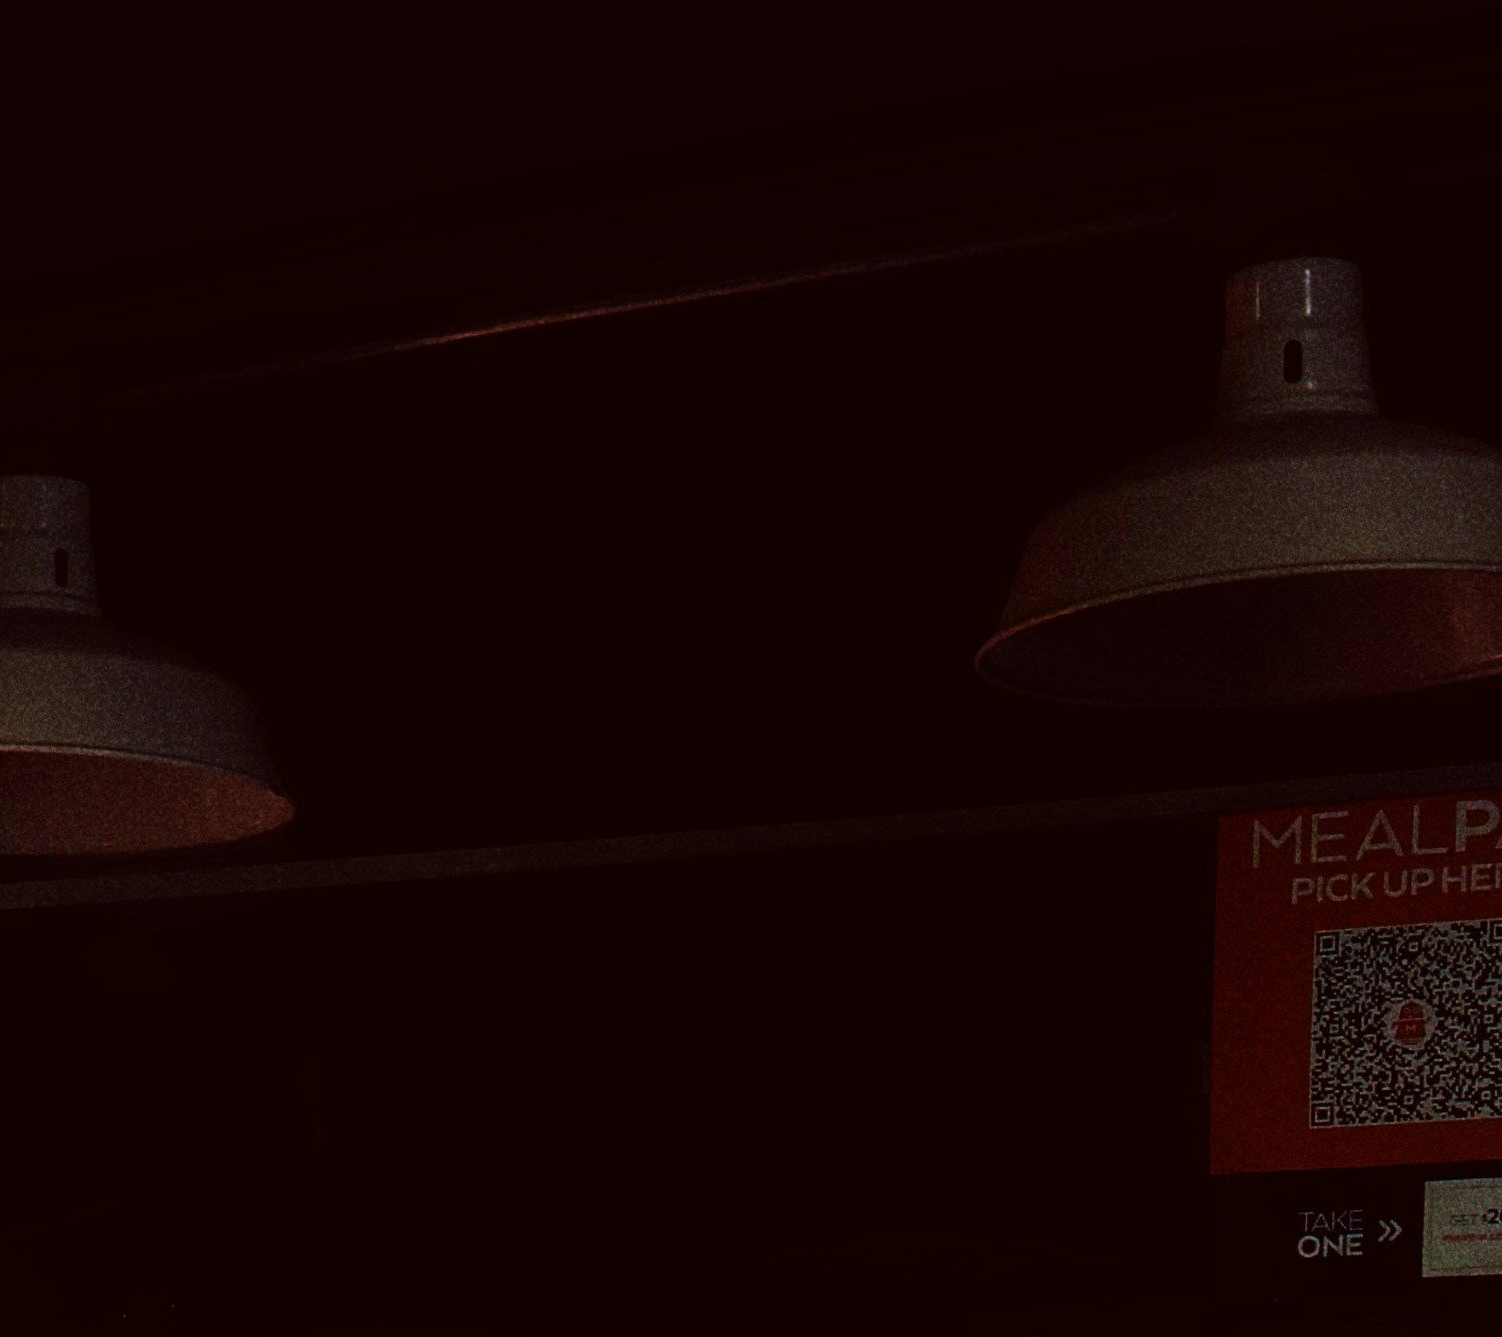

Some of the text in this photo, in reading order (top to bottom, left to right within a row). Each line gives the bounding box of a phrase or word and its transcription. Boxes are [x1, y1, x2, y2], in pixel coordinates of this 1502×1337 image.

[1252, 800, 1502, 869] MEALP
[1292, 862, 1502, 905] PICK UP HE
[1299, 1209, 1364, 1233] TAKE
[1297, 1233, 1364, 1259] ONE
